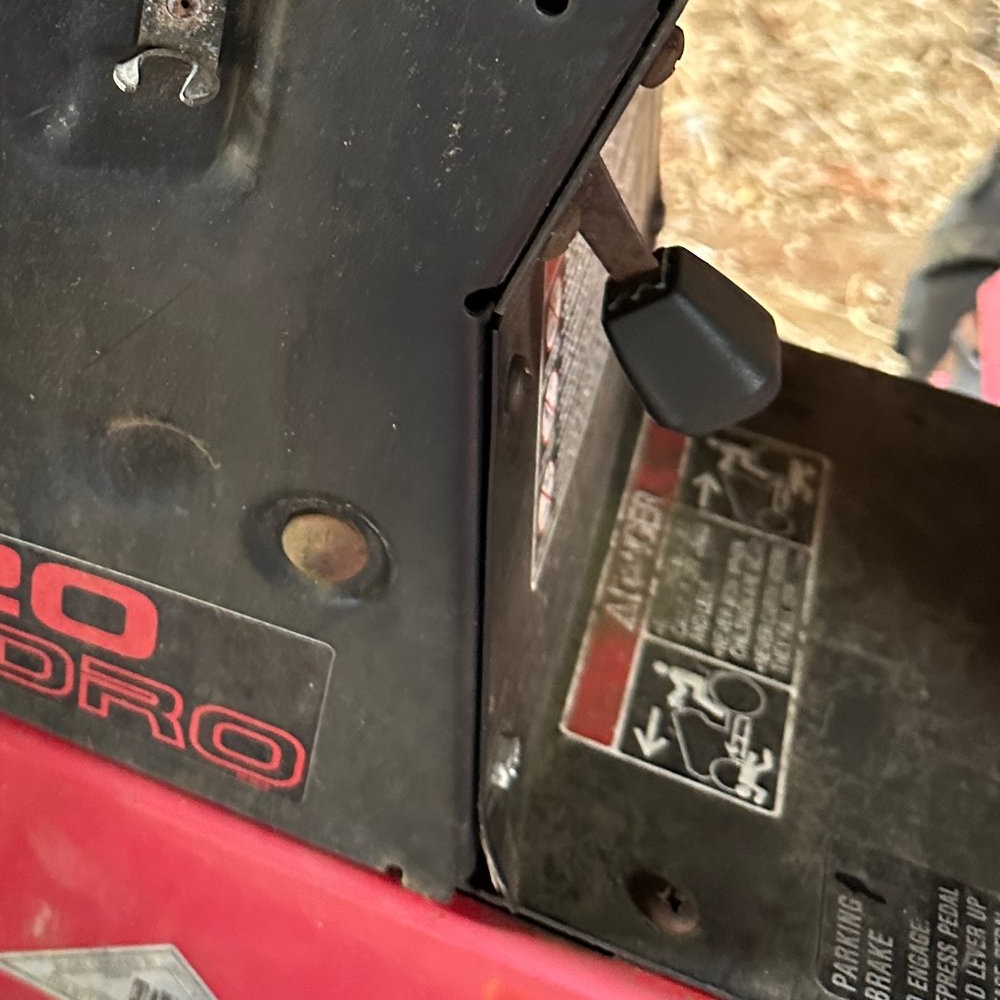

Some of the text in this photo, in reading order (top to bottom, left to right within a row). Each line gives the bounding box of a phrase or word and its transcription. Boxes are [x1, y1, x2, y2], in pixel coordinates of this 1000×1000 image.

[937, 886, 960, 938] PEDAL
[965, 896, 987, 921] UP
[831, 894, 863, 992] PARKING
[864, 928, 894, 1000] BRAKE
[965, 924, 987, 980] LEVER
